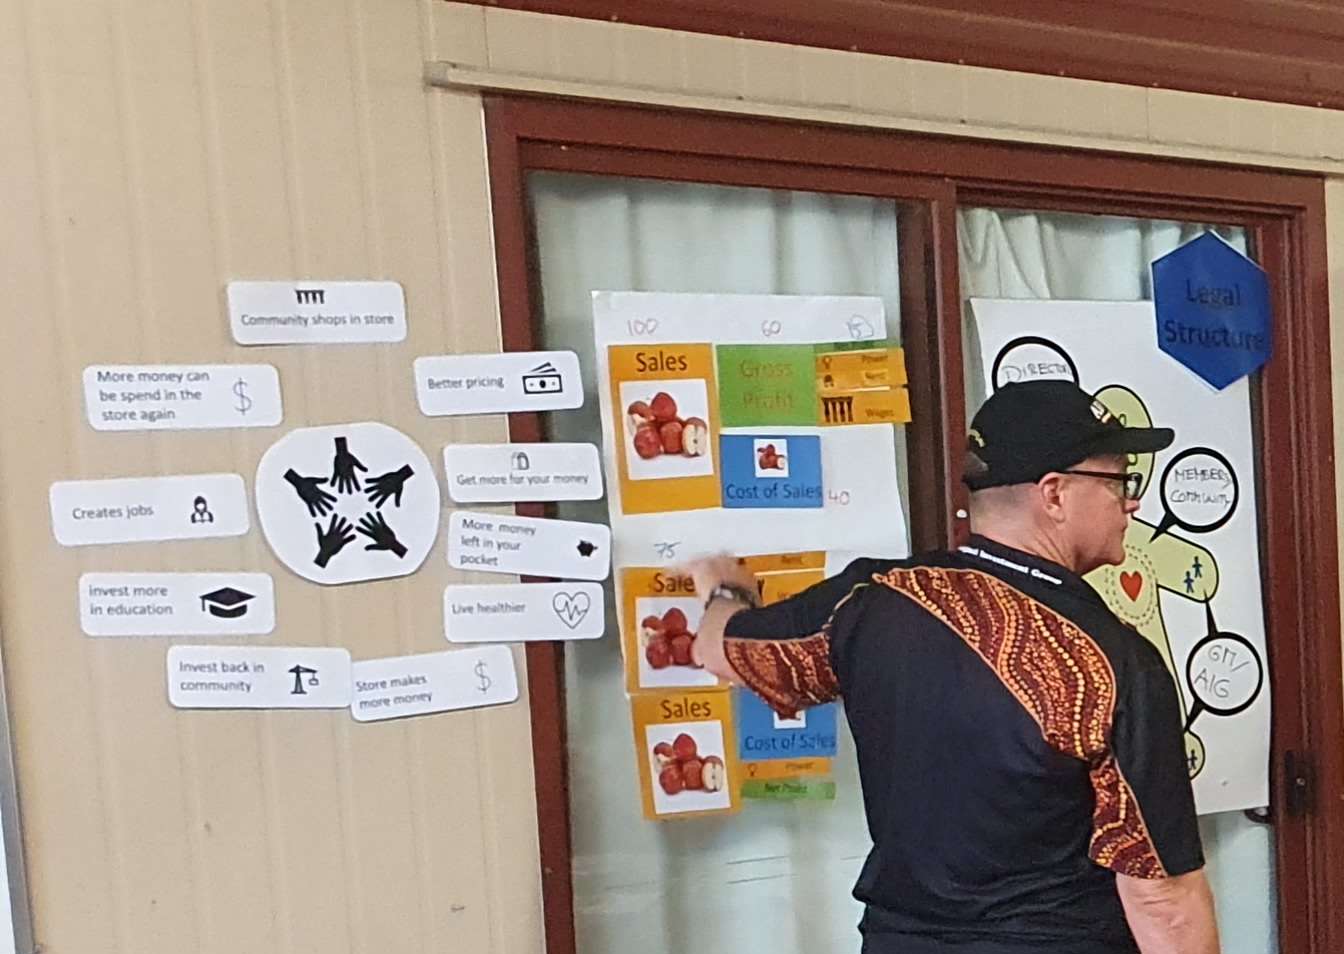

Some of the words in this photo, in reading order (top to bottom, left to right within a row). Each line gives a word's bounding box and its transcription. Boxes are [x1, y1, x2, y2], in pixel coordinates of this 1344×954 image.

[1185, 278, 1242, 309] Legal
[241, 314, 309, 328] Community
[312, 314, 347, 327] shops
[350, 313, 361, 324] in
[364, 313, 395, 325] store
[627, 318, 658, 336] 100
[761, 319, 782, 337] 60
[1164, 320, 1264, 349] Structure
[635, 350, 688, 374] Sales
[740, 359, 794, 378] Gross
[97, 370, 134, 383] More
[137, 371, 184, 385] money
[186, 371, 210, 382] can
[427, 377, 463, 390] Better
[466, 377, 504, 390] pricing
[99, 389, 117, 402] be
[120, 389, 162, 404] spend
[164, 388, 177, 400] in
[180, 388, 202, 400] the
[743, 391, 795, 410] Profit
[102, 409, 136, 421] store
[140, 408, 176, 422] again
[456, 474, 478, 486] Get
[479, 474, 507, 486] more
[509, 473, 526, 485] for
[526, 475, 551, 487] your
[553, 474, 589, 486] money
[725, 484, 759, 500] Cost
[762, 483, 780, 499] of
[783, 483, 823, 500] Sales
[827, 489, 850, 507] 40
[72, 505, 122, 520] Creates
[125, 503, 154, 519] jobs
[461, 518, 494, 532] More
[498, 521, 537, 537] money
[460, 535, 481, 548] left
[482, 537, 494, 549] in
[497, 539, 522, 552] your
[653, 541, 682, 559] 75
[460, 553, 498, 567] pocket
[136, 586, 170, 598] more
[653, 574, 695, 594] Sale
[89, 603, 103, 616] in
[106, 601, 175, 616] education
[451, 603, 474, 615] Live
[476, 602, 527, 615] healthier
[179, 660, 218, 674] Invest
[220, 660, 249, 674] back
[252, 661, 265, 673] in
[179, 678, 253, 694] community
[355, 677, 387, 694] Store
[389, 672, 427, 689] makes
[359, 694, 391, 711] more
[393, 690, 433, 708] money
[659, 699, 712, 720] Sales
[744, 735, 777, 751] Cost
[780, 734, 797, 750] of
[800, 733, 836, 750] Sales
